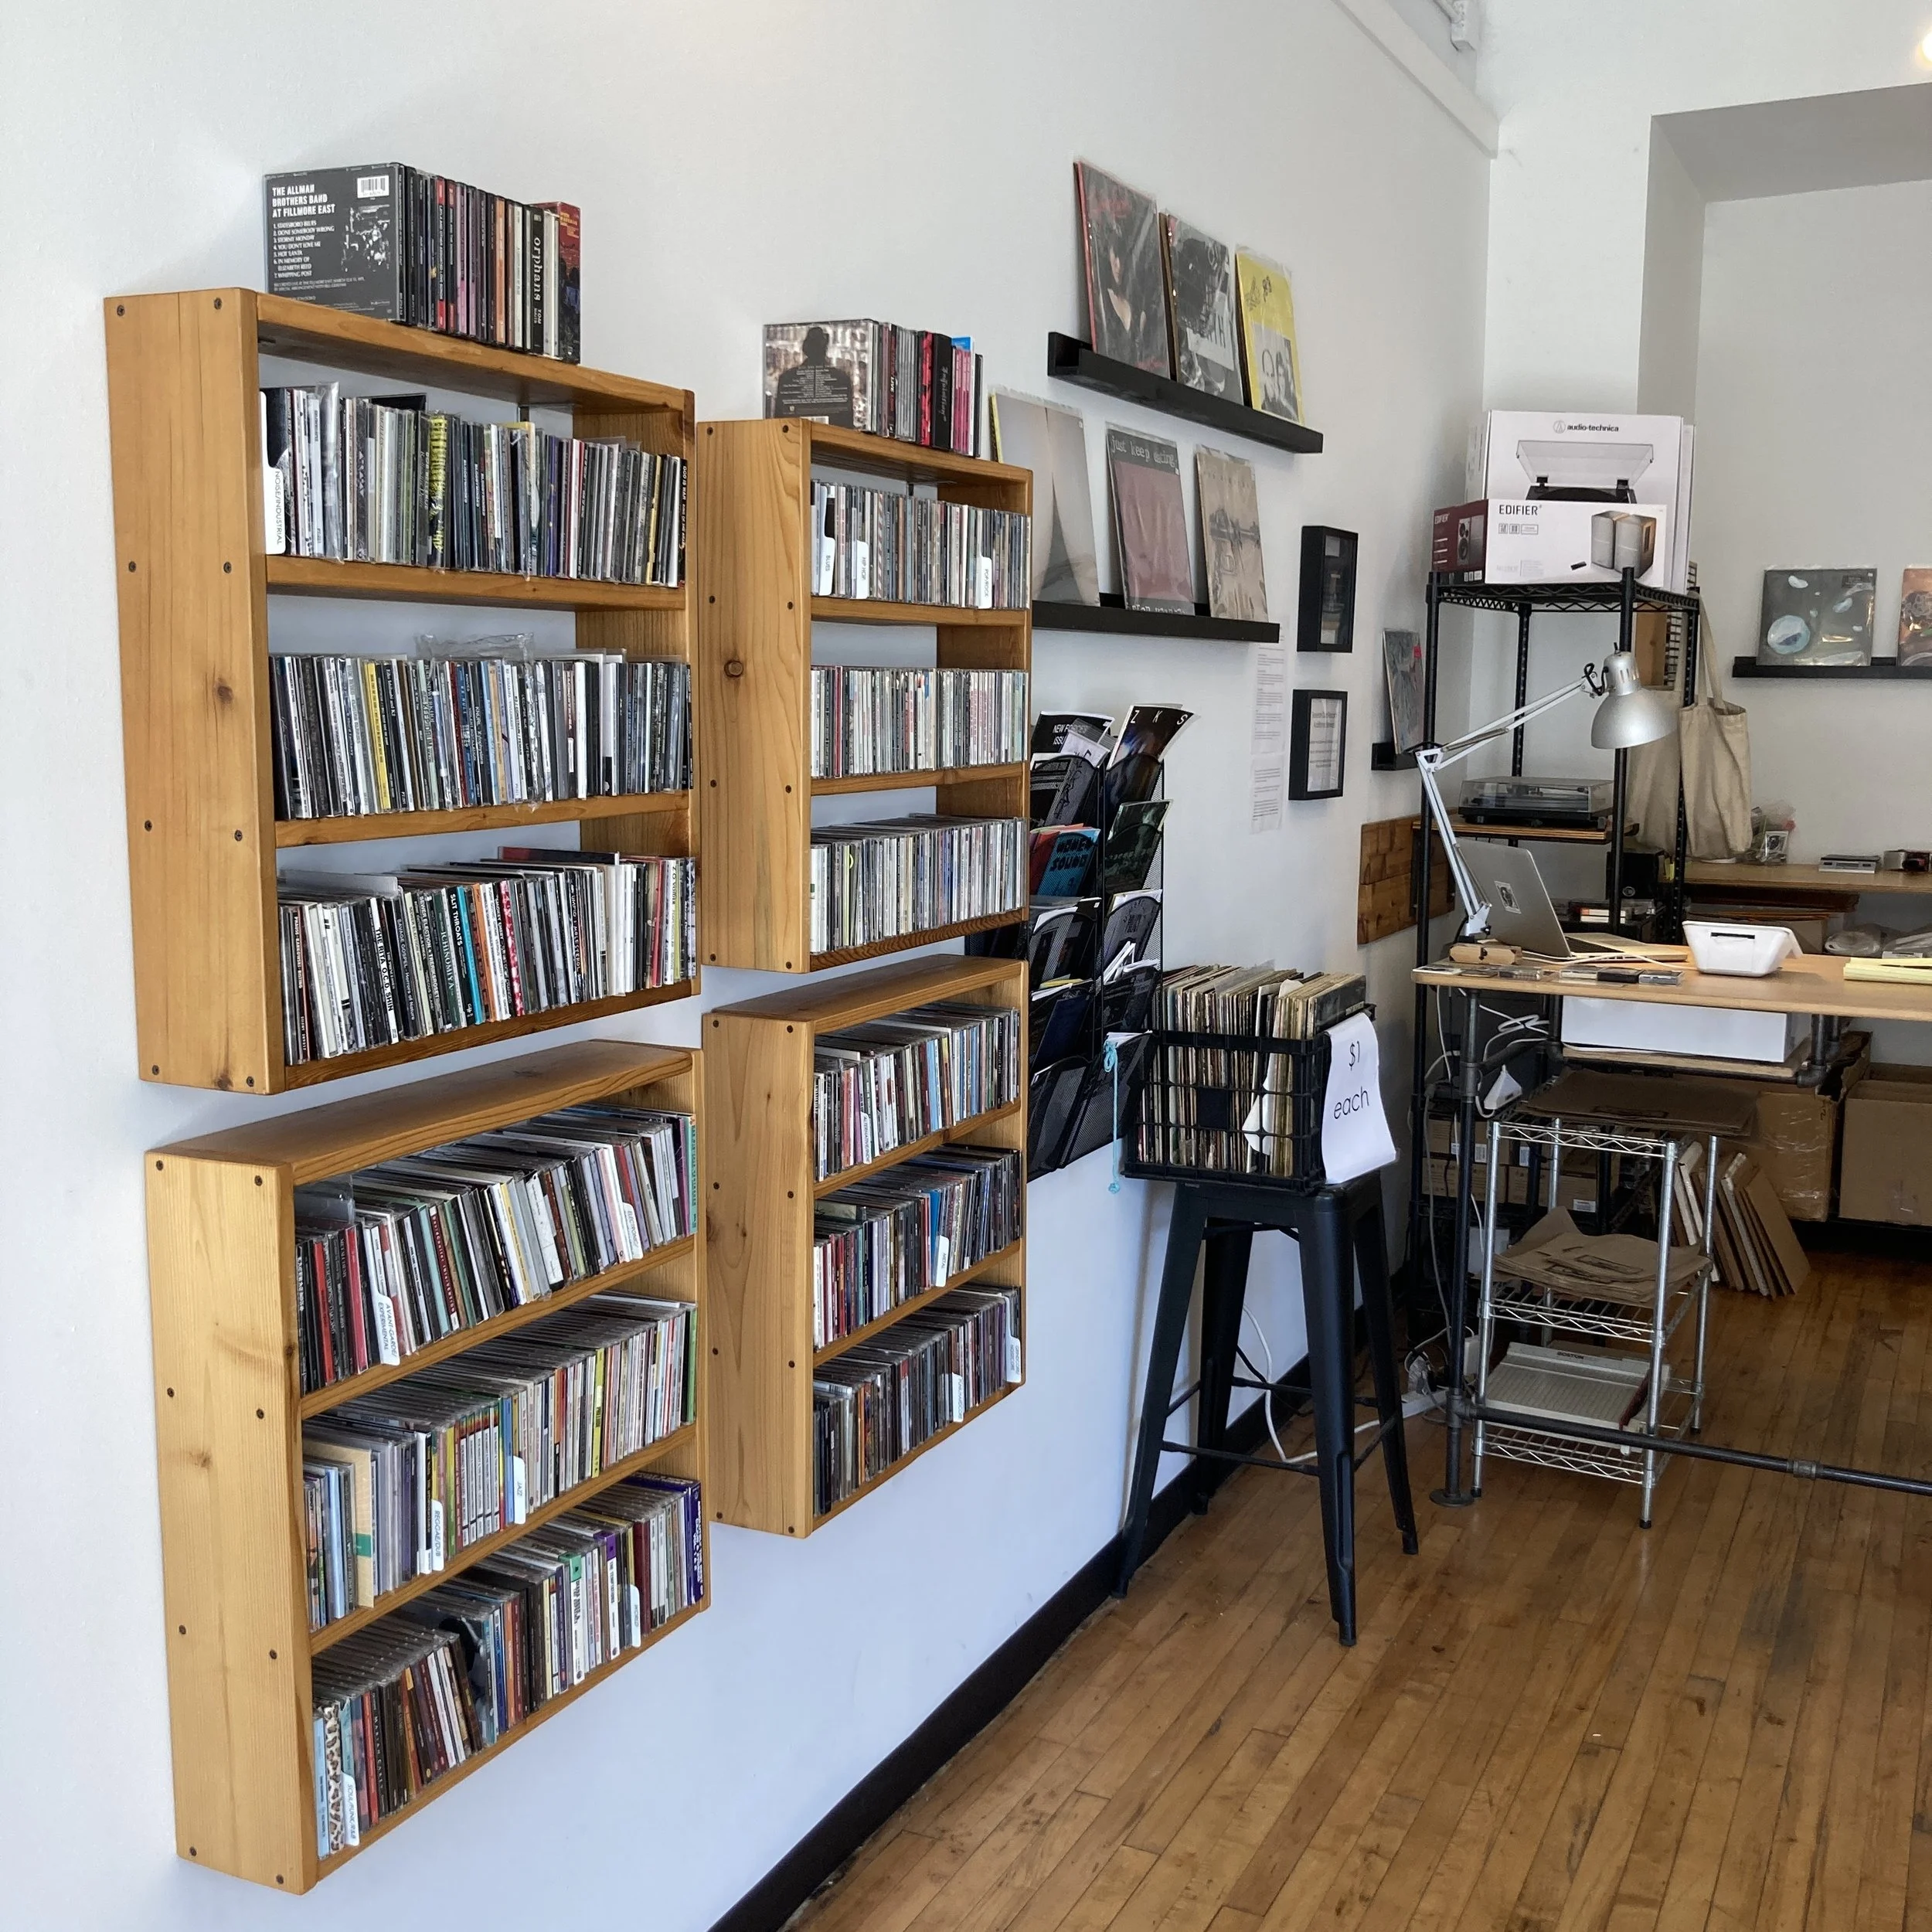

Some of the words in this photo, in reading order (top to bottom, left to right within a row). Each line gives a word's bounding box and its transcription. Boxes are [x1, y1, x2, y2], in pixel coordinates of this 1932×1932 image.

[272, 196, 308, 207] BROTHERS
[310, 194, 328, 204] BAND
[273, 187, 285, 196] THE
[287, 184, 315, 195] ALLMAN
[273, 209, 281, 218] AT
[283, 206, 316, 217] FILLMORE
[318, 204, 335, 214] EAST
[532, 237, 543, 301] orphans
[1566, 424, 1619, 433] audio-technica
[1111, 436, 1127, 453] just
[1130, 440, 1150, 462] keep
[1498, 505, 1538, 515] EDIFIER
[419, 896, 427, 918] SEWER
[450, 894, 458, 909] SLIT
[376, 927, 384, 944] THE
[451, 911, 462, 946] THROATS
[377, 945, 386, 964] RITA
[440, 931, 455, 989] ICHINOMIYA
[385, 992, 393, 1012] SHIN
[1349, 1040, 1361, 1071] $1
[1333, 1086, 1369, 1120] each
[378, 1301, 389, 1350] EXPERIMENTAL
[386, 1304, 397, 1358] AVANT-GARDE/
